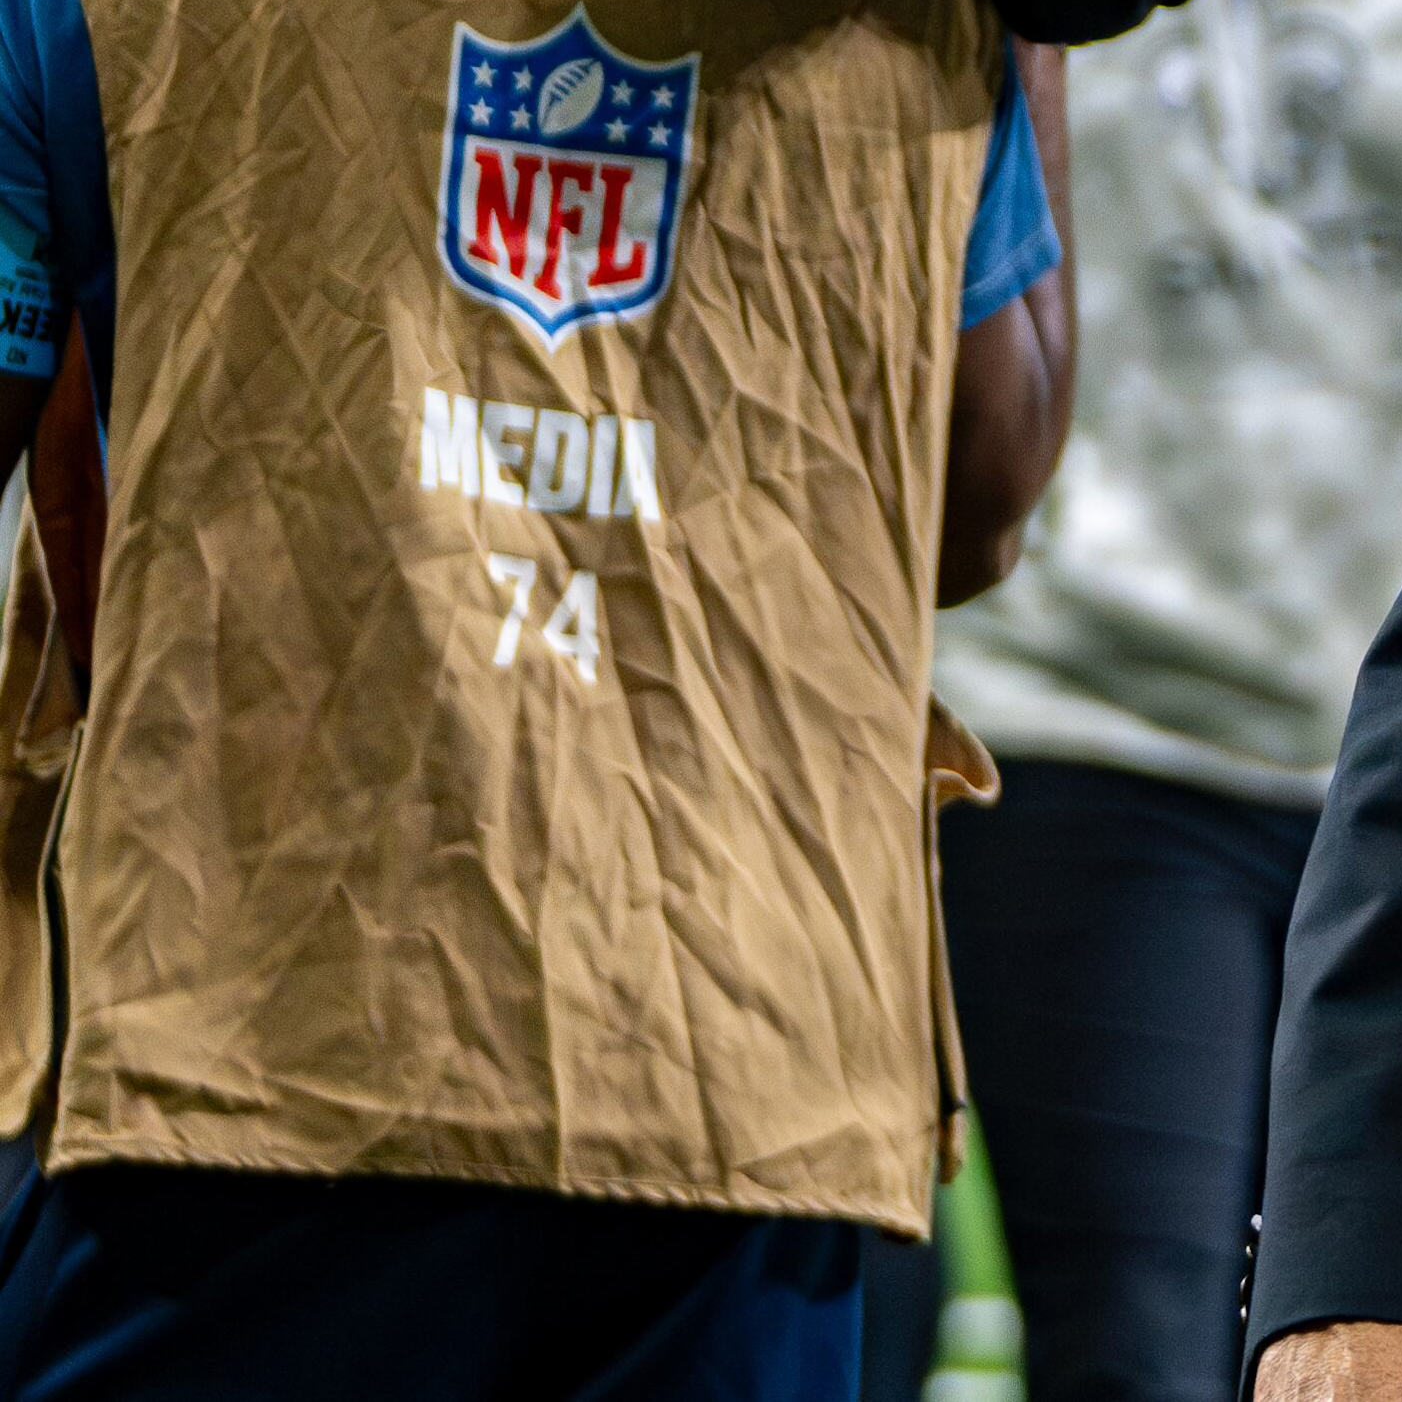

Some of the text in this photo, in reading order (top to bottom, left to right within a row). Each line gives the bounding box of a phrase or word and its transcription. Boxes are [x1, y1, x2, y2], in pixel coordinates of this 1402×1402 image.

[468, 147, 647, 301] NFL
[419, 386, 661, 522] MEDIA
[488, 551, 600, 685] 74
